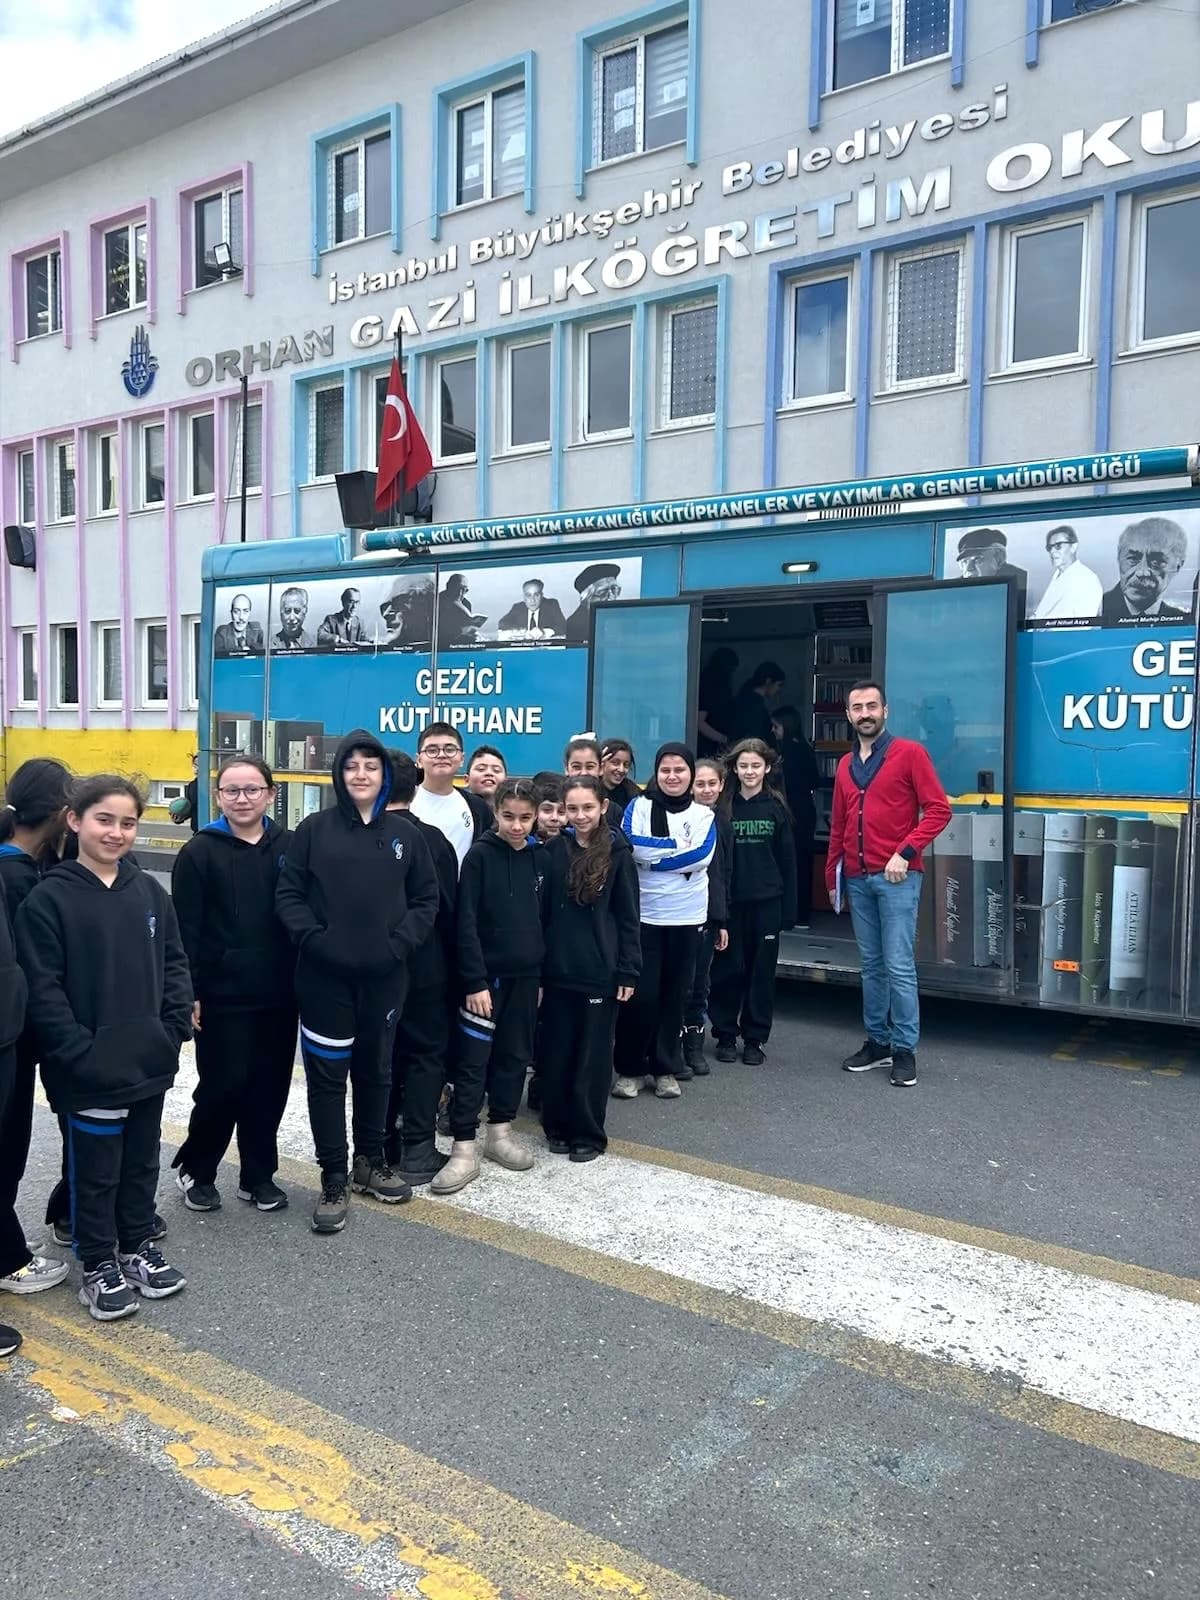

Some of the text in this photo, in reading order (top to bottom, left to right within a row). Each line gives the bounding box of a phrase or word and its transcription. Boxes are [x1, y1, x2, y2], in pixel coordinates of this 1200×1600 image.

[329, 83, 1008, 304] İstanbul Büyükşehir Belediyesi
[185, 100, 1200, 387] ORHAN GAZİ İLKÖĞRETİM OKU
[404, 454, 1142, 546] T.C. KÜLTÜR VE TURİZM BAKANLIĞI KÜTÜPHANELER VE YAYIMLAR GENEL MÜDÜRLÜĞÜ
[416, 660, 504, 696] GEZİCİ
[1132, 640, 1196, 677] GE
[379, 702, 543, 734] KÜTÜPHANE
[1063, 686, 1194, 730] KÜTÜ
